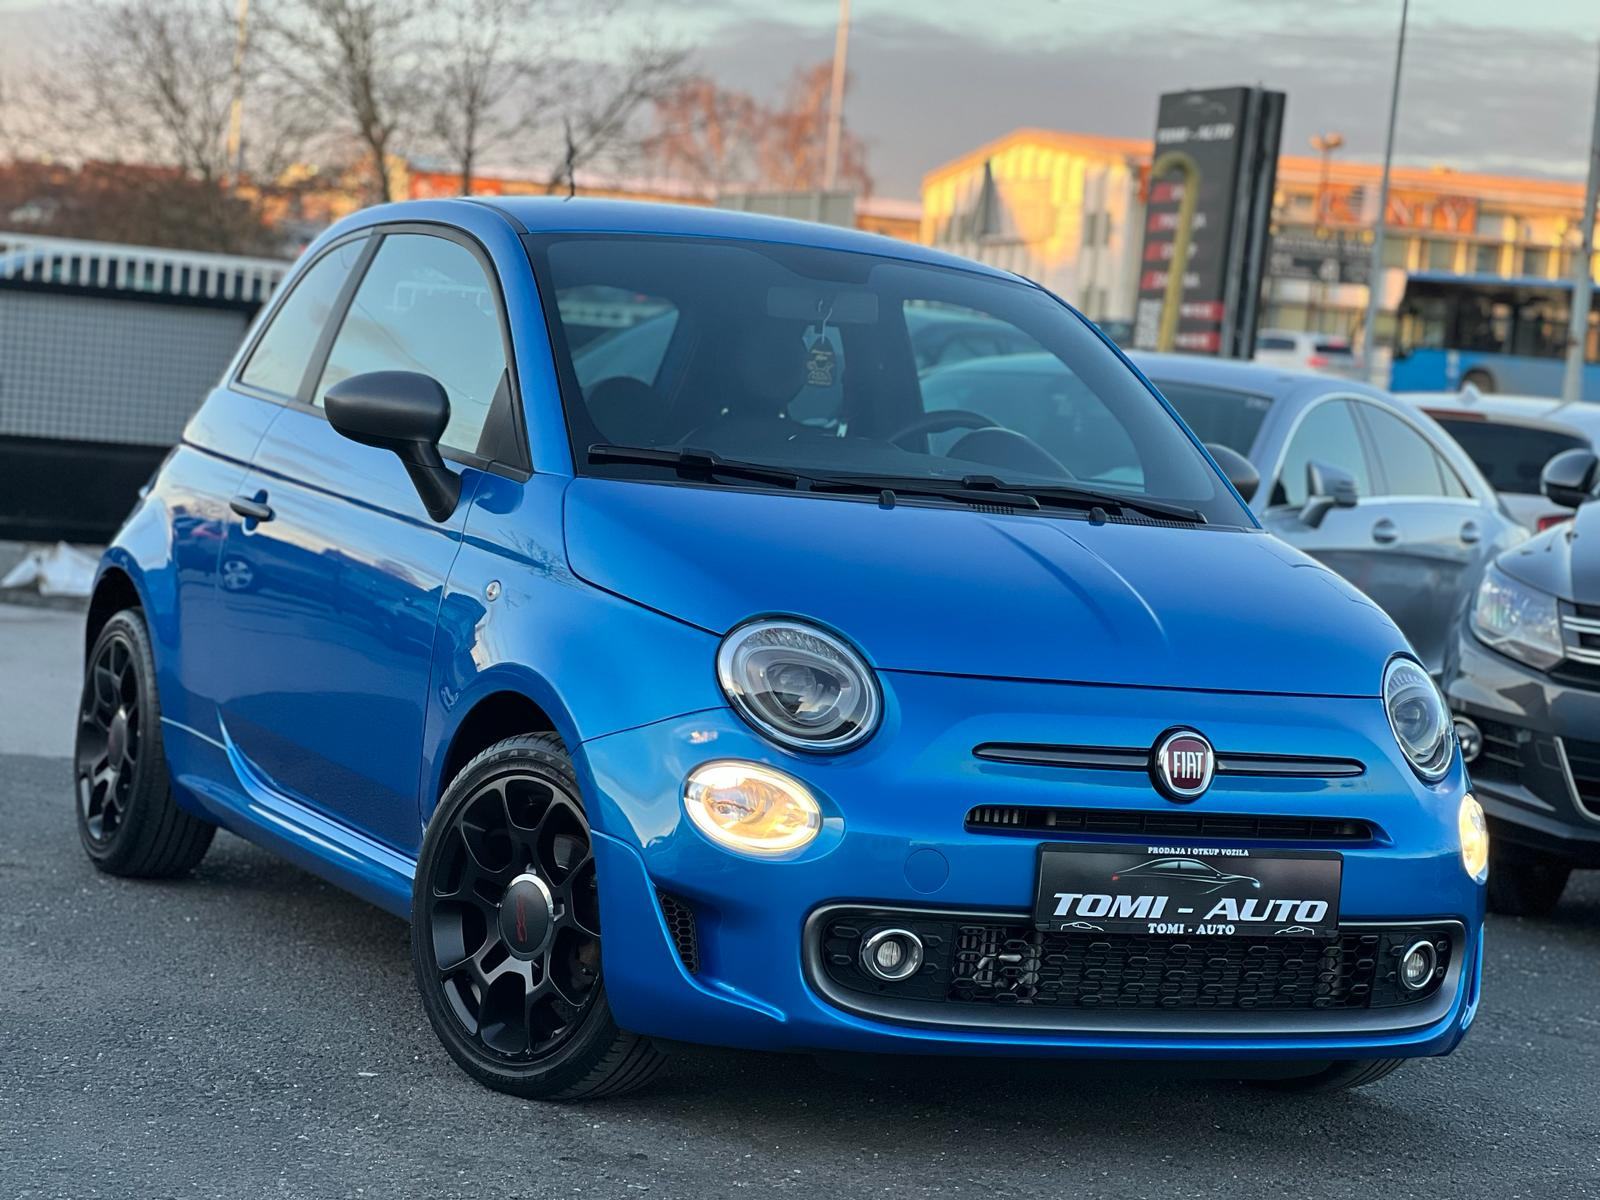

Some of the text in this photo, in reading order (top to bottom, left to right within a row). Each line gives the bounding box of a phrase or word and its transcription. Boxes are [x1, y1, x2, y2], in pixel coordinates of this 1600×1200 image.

[1173, 751, 1204, 779] FIAT
[1147, 847, 1186, 855] PRODAJA
[1192, 848, 1219, 856] OTKUP
[1221, 848, 1249, 857] VOZILA
[1053, 893, 1169, 919] TOMI
[1203, 898, 1329, 922] AUTO
[1148, 923, 1185, 934] TOMI
[1196, 924, 1236, 935] AUTO
